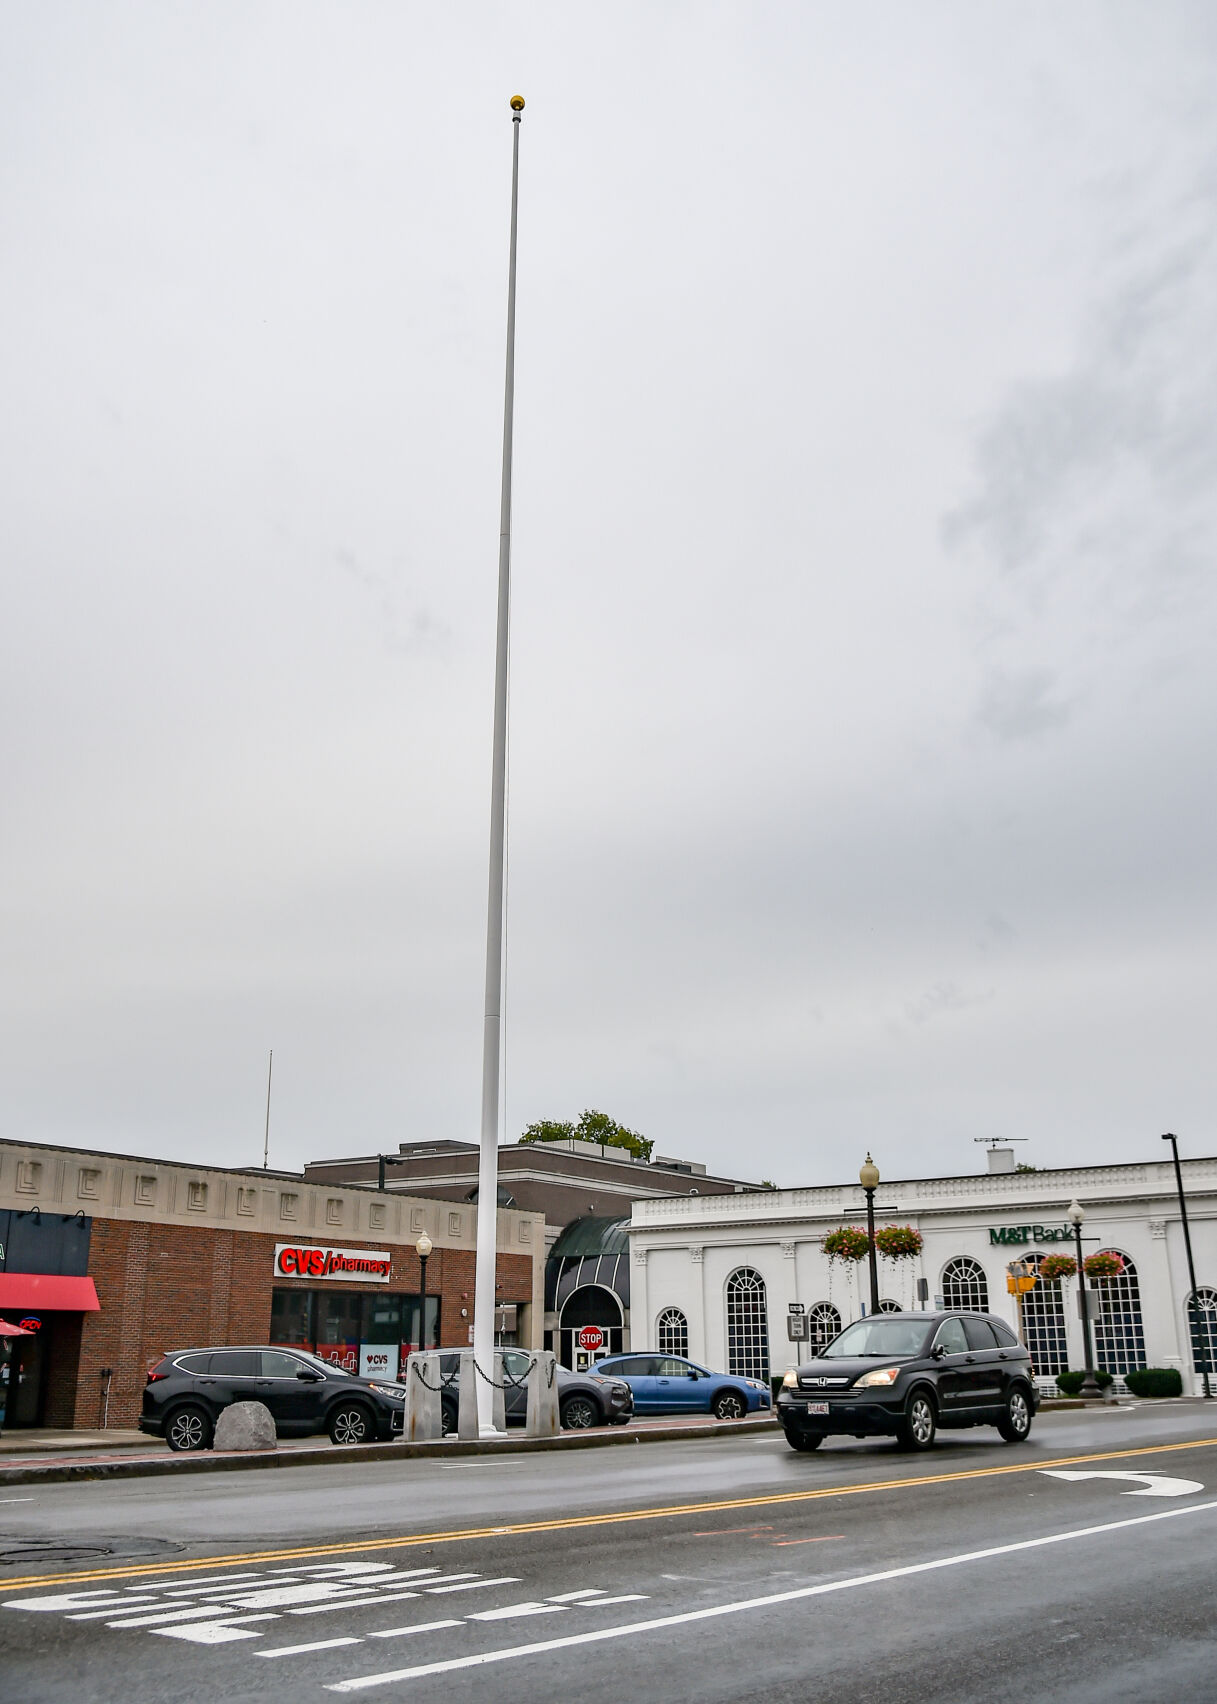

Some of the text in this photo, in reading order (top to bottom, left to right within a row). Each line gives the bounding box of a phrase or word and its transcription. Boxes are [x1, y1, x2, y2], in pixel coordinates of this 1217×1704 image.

[988, 1224, 1074, 1245] M&T Bank
[580, 1333, 602, 1343] STOP
[373, 1354, 388, 1364] CVS
